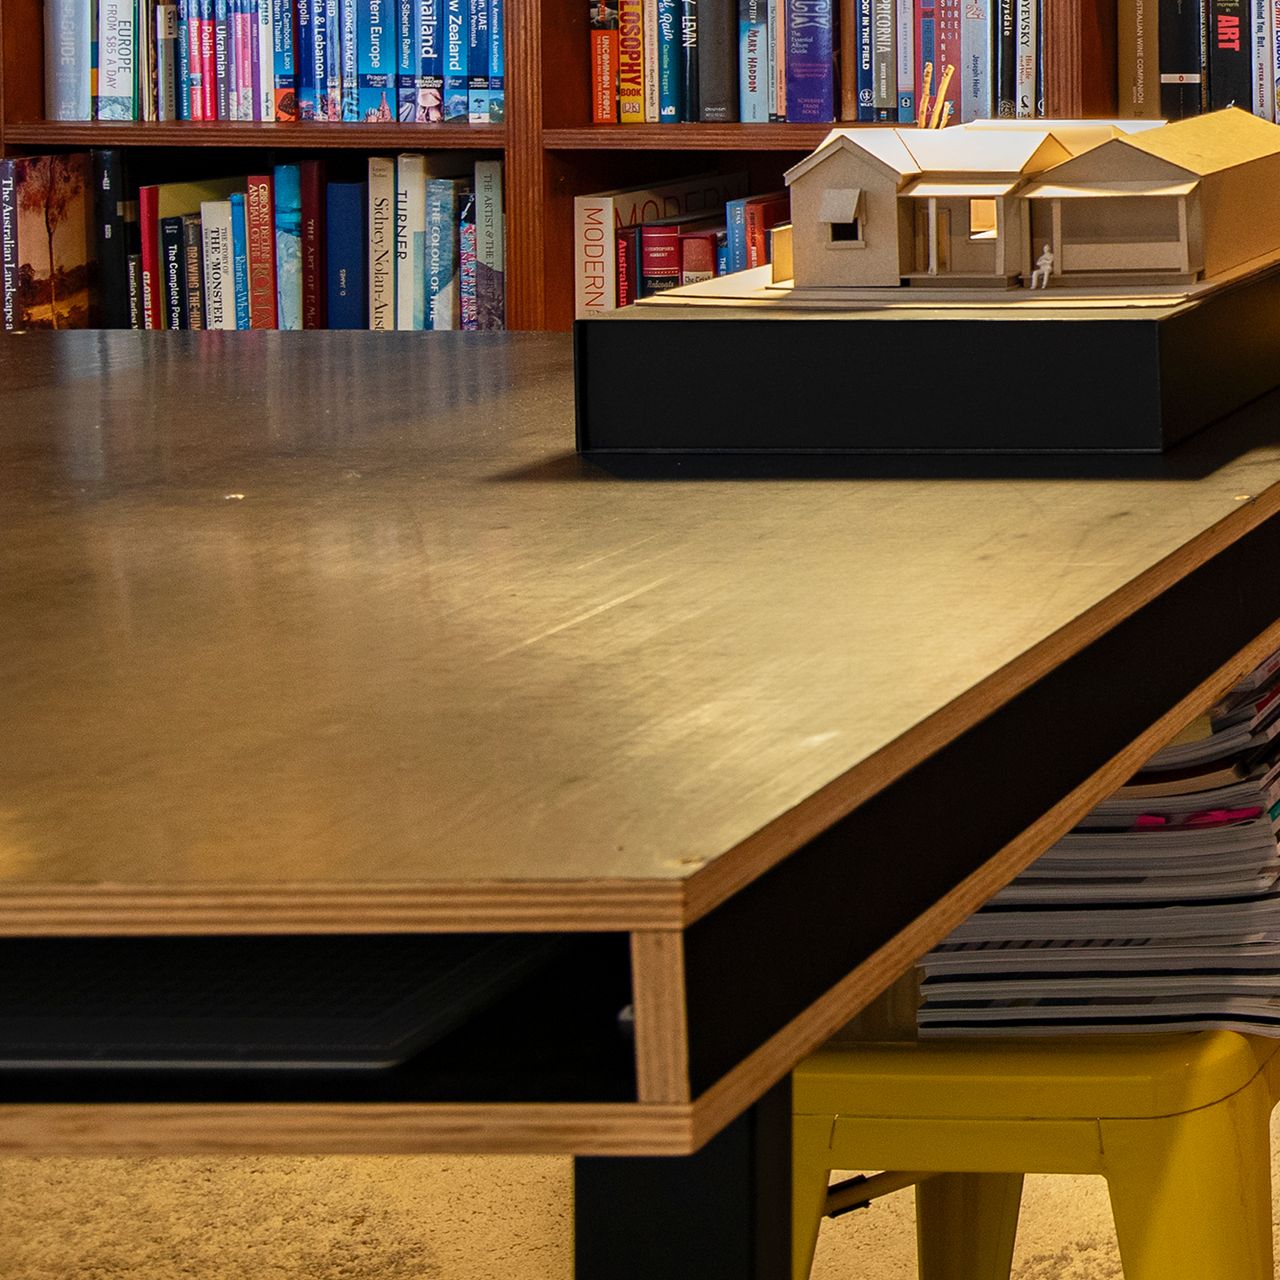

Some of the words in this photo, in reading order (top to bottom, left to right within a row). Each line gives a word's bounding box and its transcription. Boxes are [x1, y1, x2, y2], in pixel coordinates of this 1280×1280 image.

[107, 4, 117, 30] FROM
[1218, 15, 1240, 50] ART
[106, 34, 117, 55] $85
[119, 20, 132, 73] EUROPE
[202, 26, 213, 57] Polish
[215, 26, 227, 77] Ukrainian
[315, 28, 326, 78] Lebanon
[368, 27, 383, 68] Europe
[448, 14, 462, 70] Zealand
[747, 28, 759, 53] MARK
[106, 67, 117, 88] DAY
[748, 56, 759, 92] HADDON
[583, 207, 604, 307] MODERN
